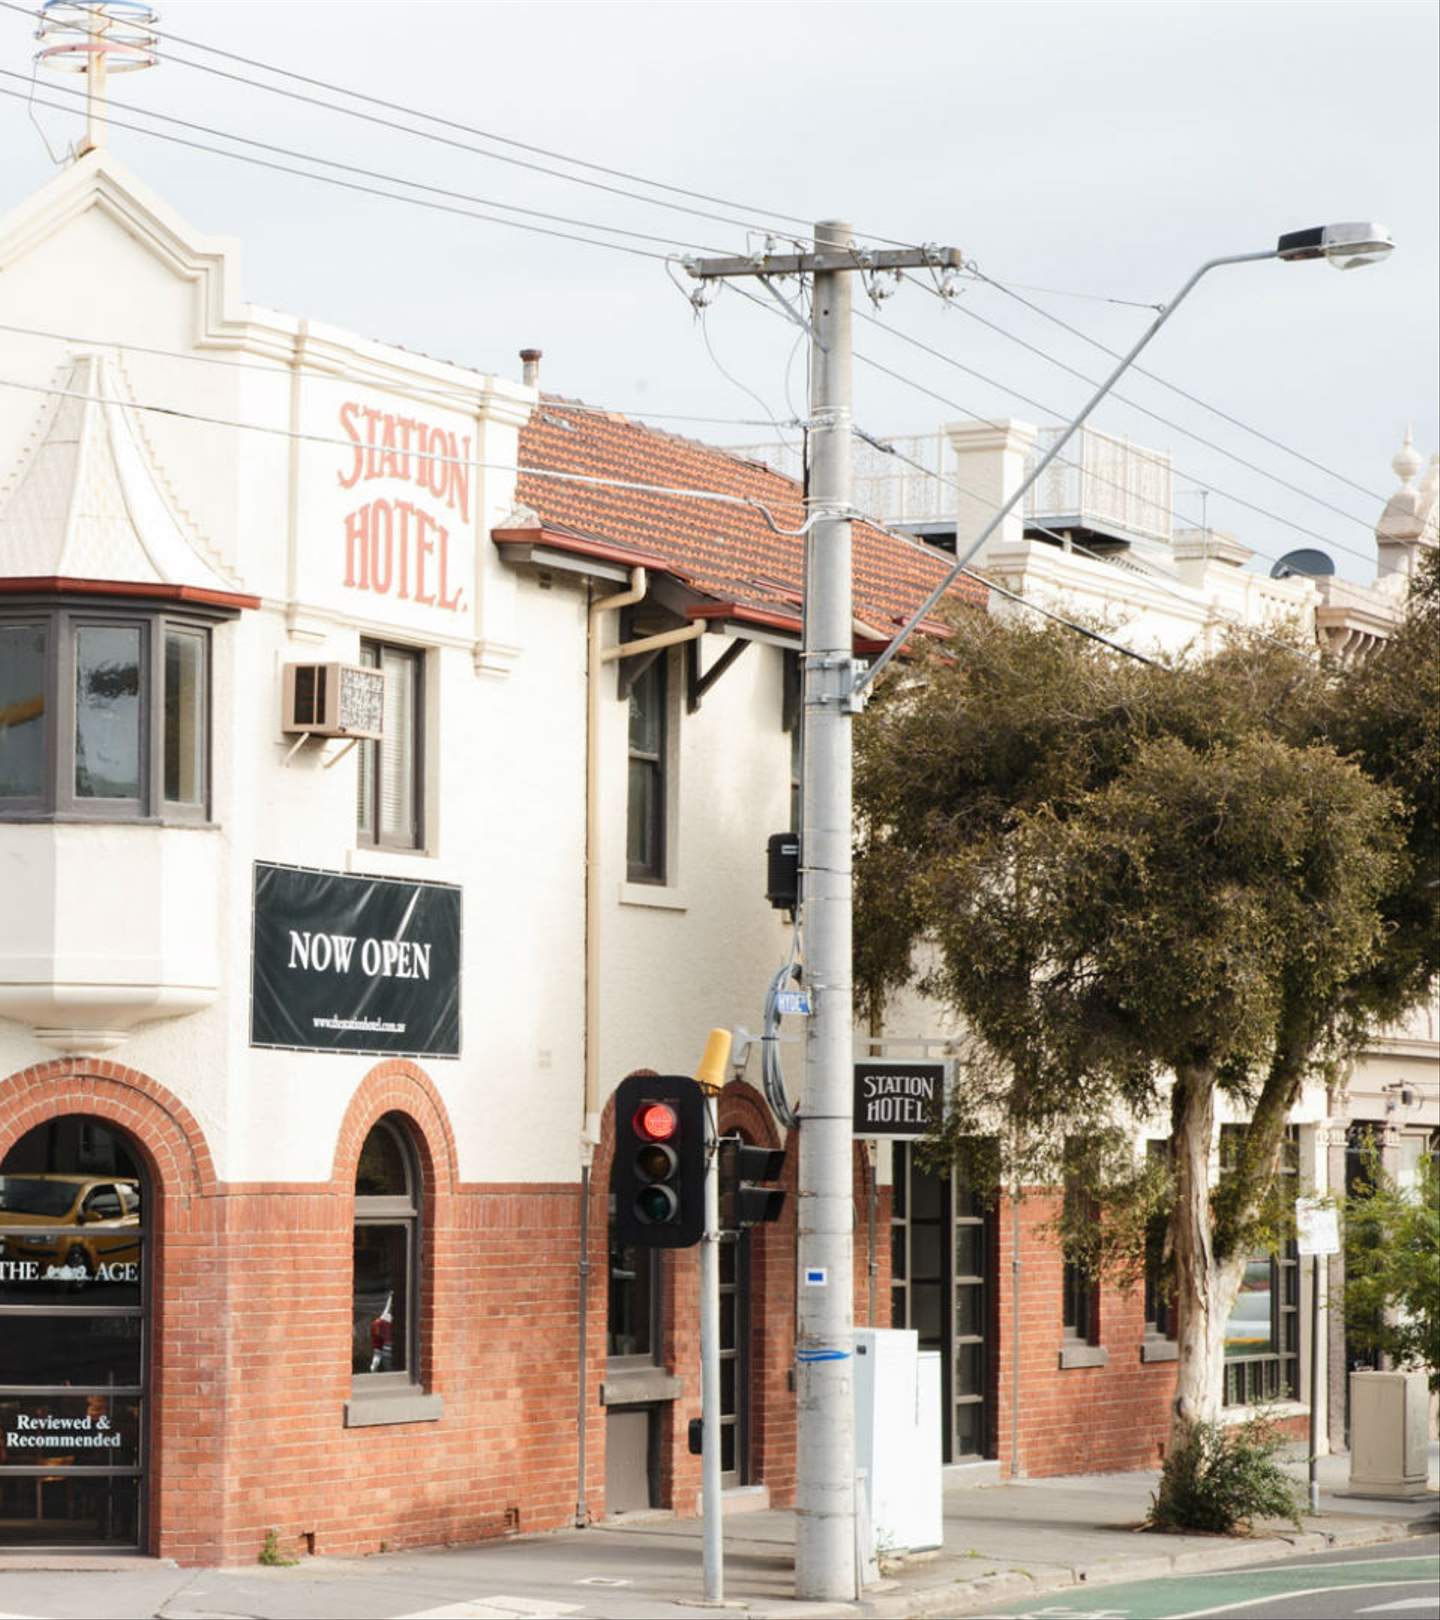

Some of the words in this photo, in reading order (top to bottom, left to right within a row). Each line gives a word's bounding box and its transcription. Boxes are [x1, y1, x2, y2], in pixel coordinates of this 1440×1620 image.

[337, 401, 471, 525] STATION
[288, 930, 356, 974] NOW
[361, 938, 431, 980] OPEN
[864, 1076, 934, 1099] STATION
[95, 1262, 139, 1281] AGE
[17, 1414, 91, 1430] Reviewed
[96, 1415, 111, 1430] &
[6, 1432, 121, 1448] Recommended
